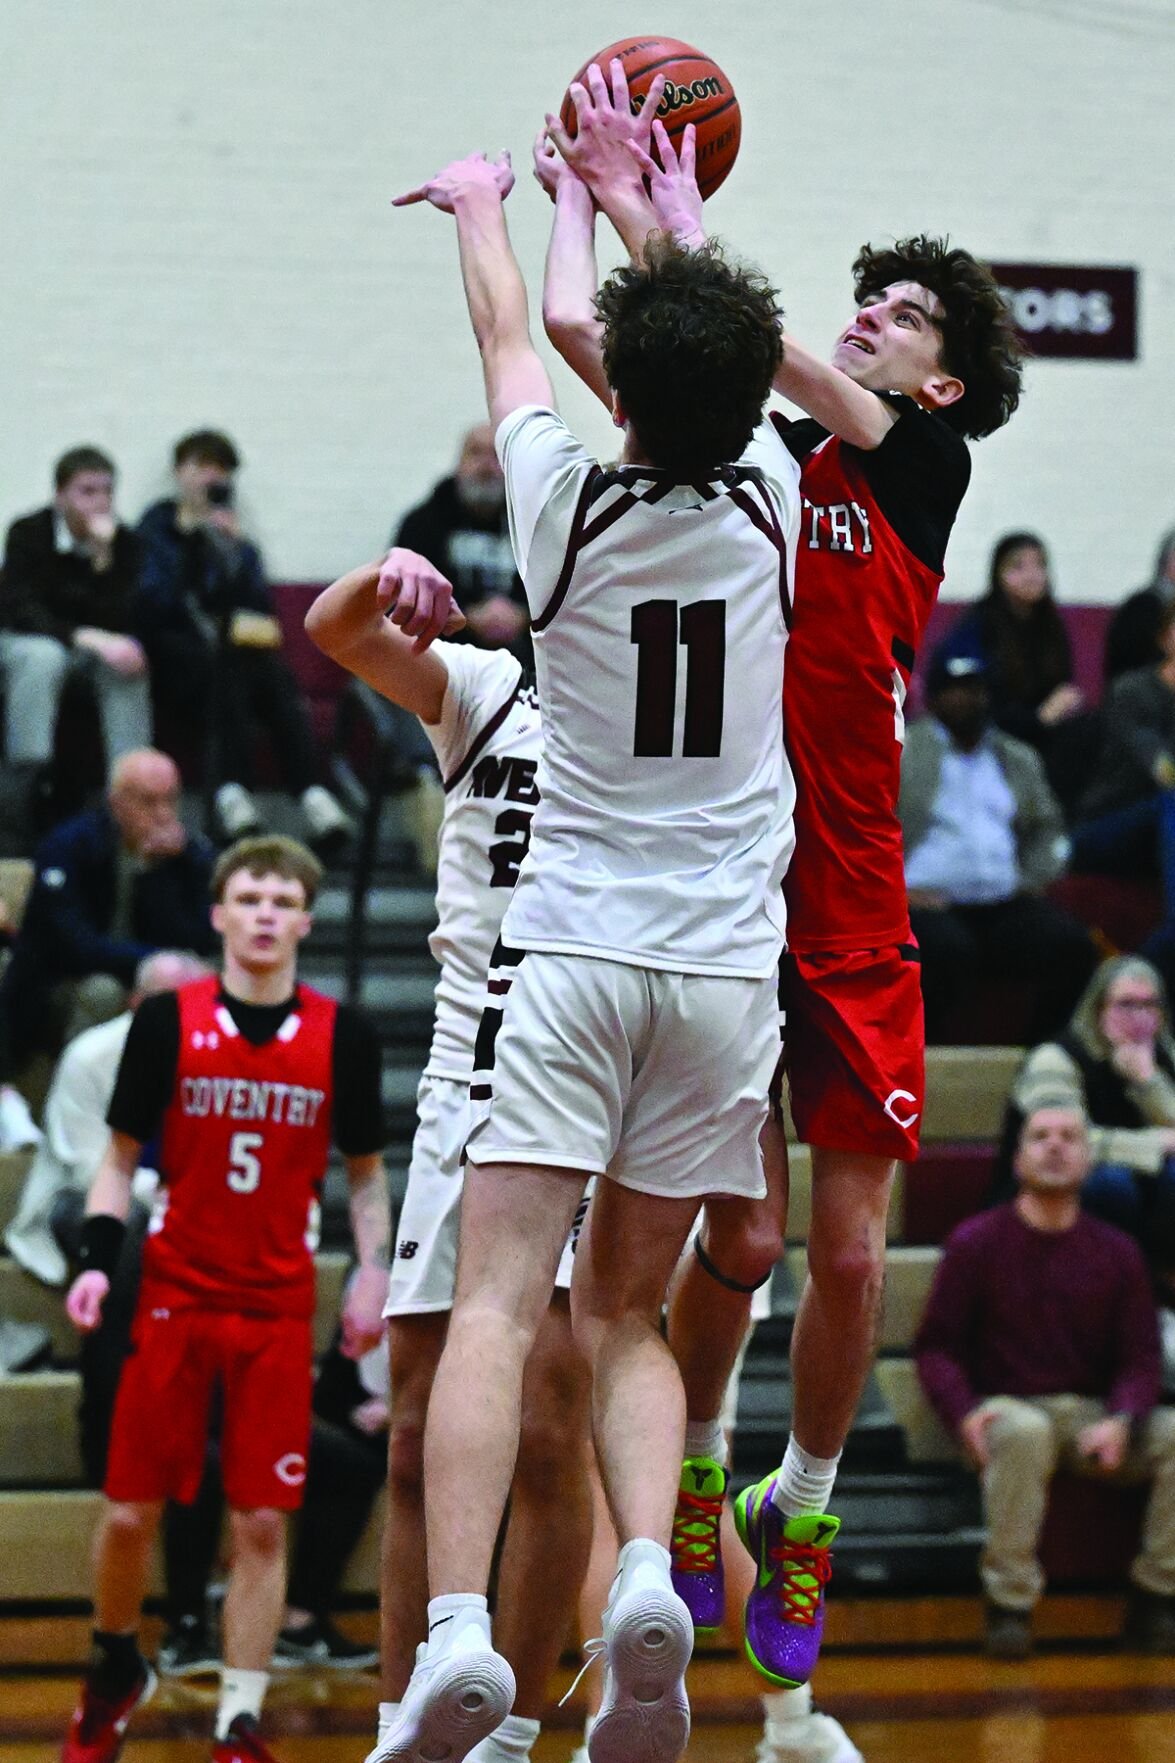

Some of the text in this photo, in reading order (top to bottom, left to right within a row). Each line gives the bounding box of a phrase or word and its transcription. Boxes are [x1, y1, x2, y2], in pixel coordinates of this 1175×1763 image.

[631, 76, 725, 118] lson
[804, 498, 872, 554] TRY
[631, 598, 726, 758] 11
[489, 807, 535, 888] 2
[181, 1075, 325, 1128] COVENTRY
[883, 1088, 919, 1130] C
[226, 1131, 264, 1195] 5
[273, 1451, 307, 1487] C
